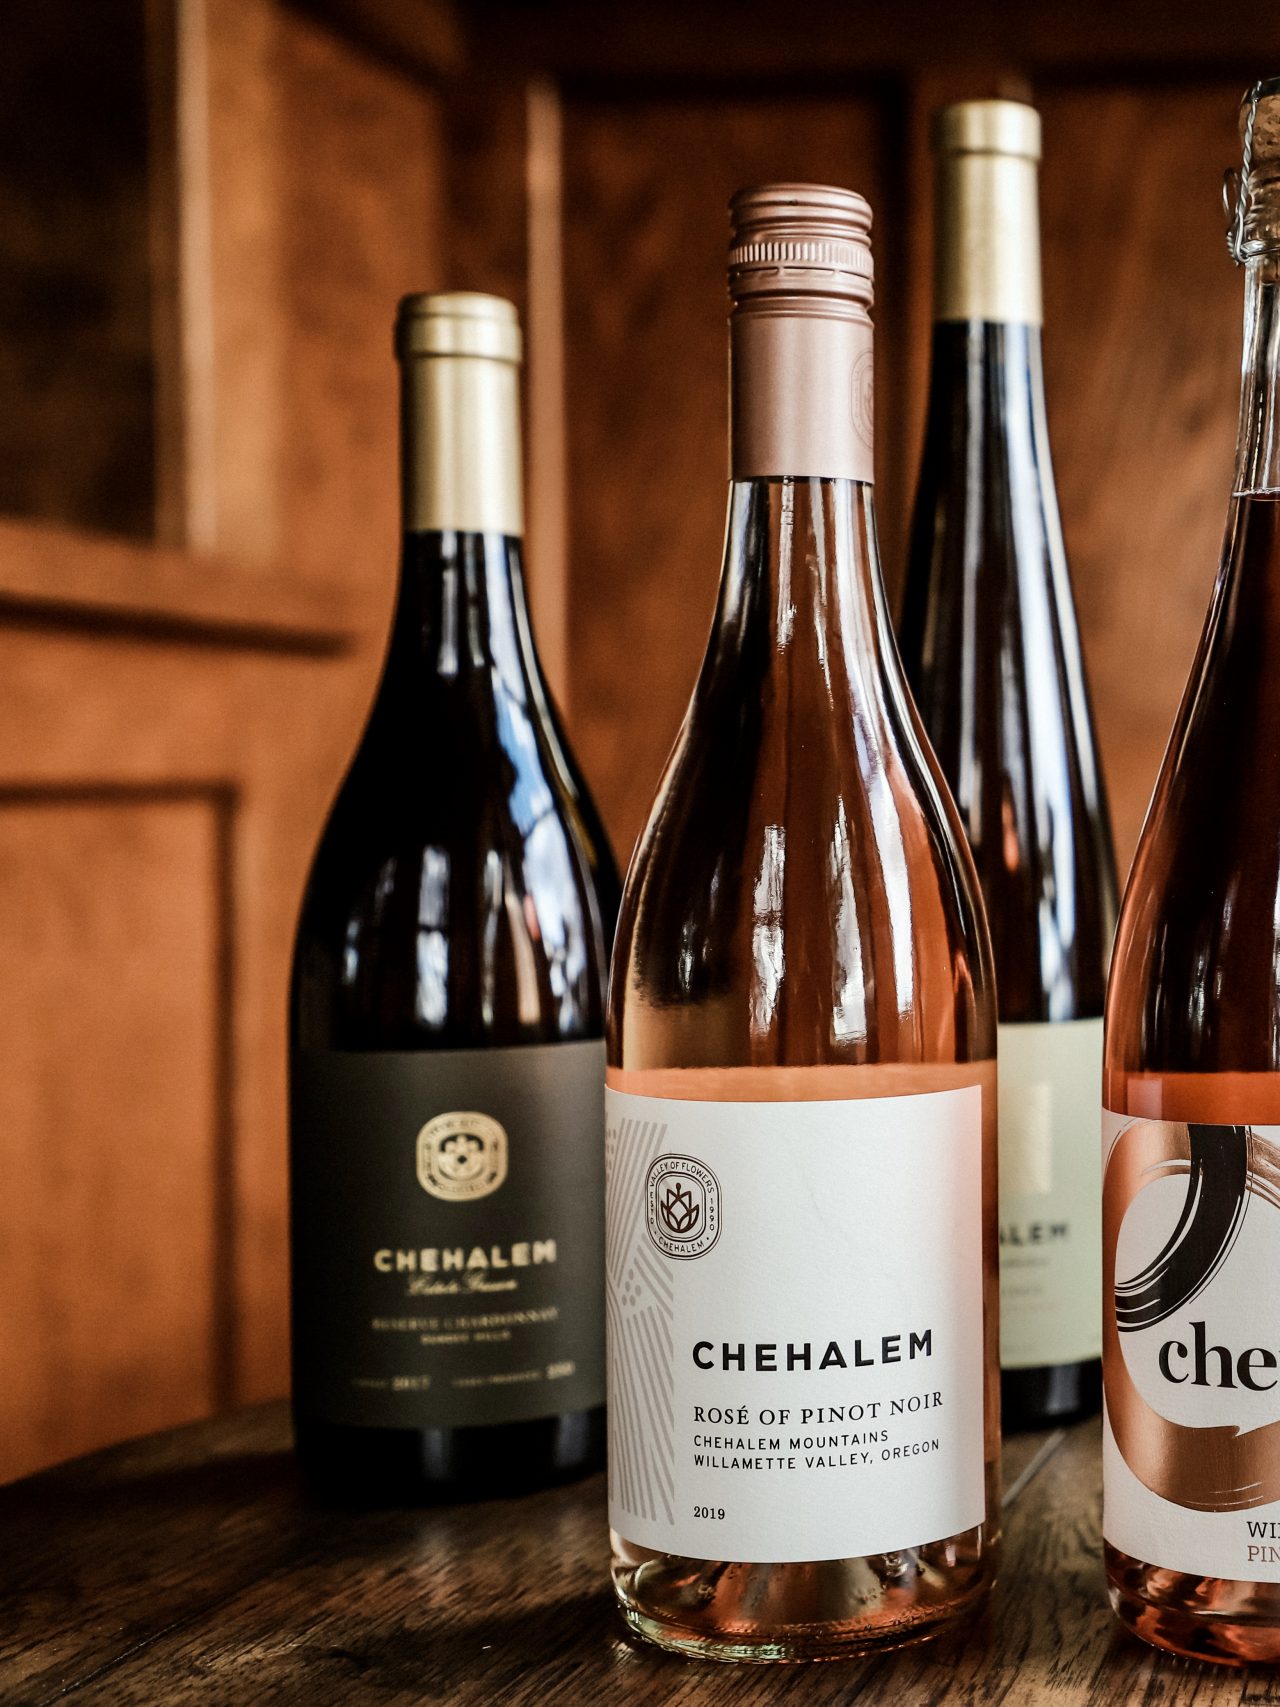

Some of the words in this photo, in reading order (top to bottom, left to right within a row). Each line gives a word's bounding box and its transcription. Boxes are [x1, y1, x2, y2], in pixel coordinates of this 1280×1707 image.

[650, 1162, 669, 1187] VALLEY
[670, 1161, 680, 1170] OF
[681, 1162, 715, 1194] FLOWERS
[373, 1239, 557, 1273] CHEHALEM
[658, 1236, 705, 1253] CHEHALEM
[693, 1329, 932, 1372] CHEHALEM
[693, 1405, 750, 1425] ROSÉ
[759, 1409, 791, 1426] OF
[801, 1402, 881, 1425] PINOT
[889, 1391, 944, 1416] NOIR
[693, 1434, 780, 1451] CHEHALEM
[789, 1429, 889, 1450] MOUNTAINS
[693, 1454, 796, 1470] WILLAMETTE
[805, 1452, 874, 1469] VALLEY,
[881, 1438, 940, 1461] OREGON
[693, 1505, 726, 1520] 2019
